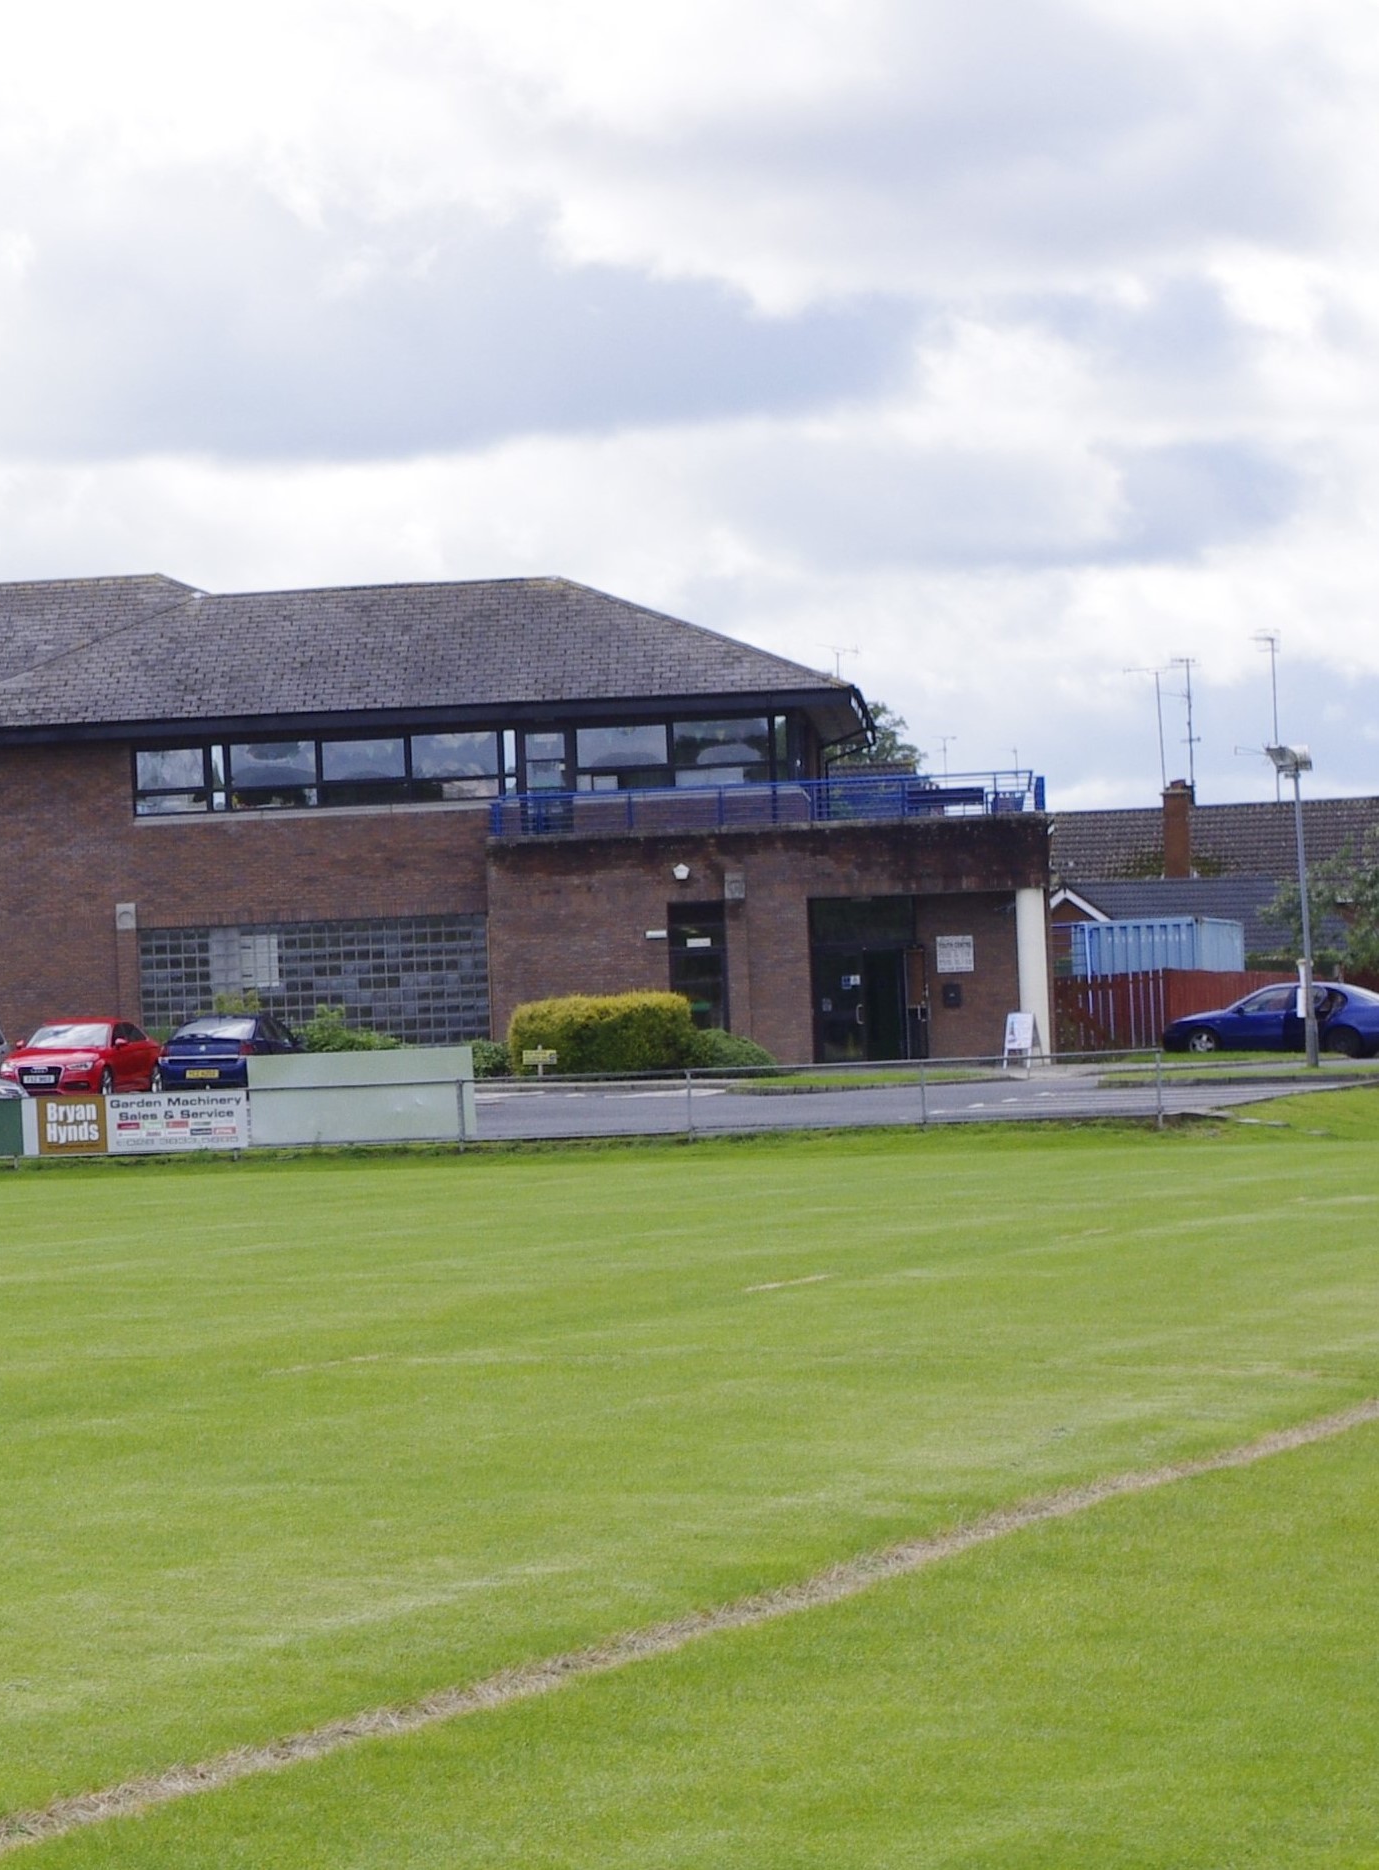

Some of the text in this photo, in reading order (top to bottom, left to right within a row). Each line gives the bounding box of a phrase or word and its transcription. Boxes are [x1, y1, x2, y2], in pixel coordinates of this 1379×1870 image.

[110, 1096, 242, 1109] Garden Machinery
[46, 1102, 98, 1122] Bryan
[119, 1109, 234, 1121] Sales & Service
[46, 1122, 99, 1144] Hynds
